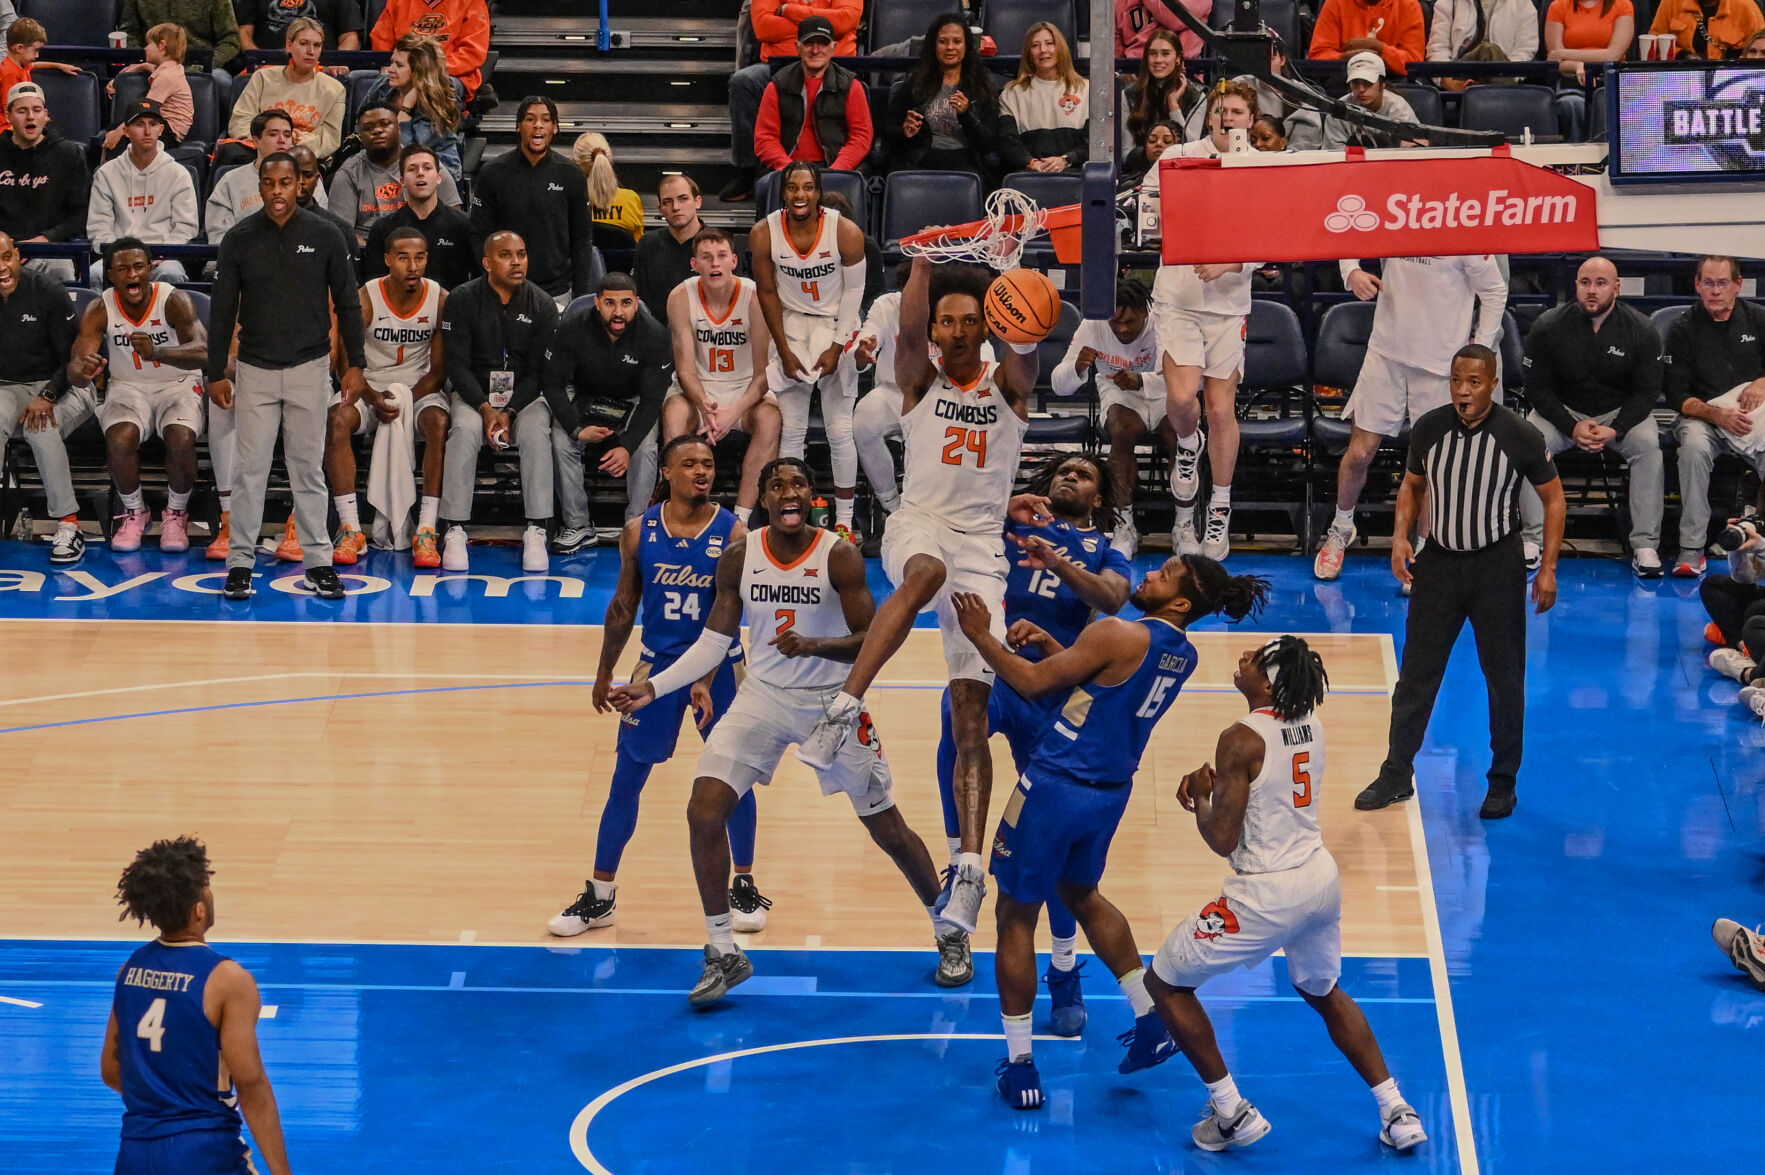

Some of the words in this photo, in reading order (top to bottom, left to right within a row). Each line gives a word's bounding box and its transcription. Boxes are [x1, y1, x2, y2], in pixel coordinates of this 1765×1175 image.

[1673, 109, 1762, 136] BATTLE
[780, 263, 836, 279] COWBOYS
[800, 280, 820, 301] 4
[994, 282, 1026, 324] Wilson
[114, 331, 169, 347] COYS
[374, 328, 431, 343] COWBOYS
[696, 328, 748, 346] COWBOYS
[397, 345, 405, 366] 1
[708, 347, 735, 372] 13
[934, 398, 998, 425] COWBOYS
[941, 425, 988, 468] 24
[647, 519, 658, 527] 32
[651, 562, 714, 588] Tulsa
[1028, 569, 1061, 599] 12
[663, 591, 701, 620] 24
[750, 583, 821, 604] COWBOYS
[774, 608, 796, 635] 2
[1158, 653, 1188, 673] GARCIA
[1135, 675, 1177, 718] 15
[1280, 724, 1313, 746] WILLIAMS
[1292, 751, 1312, 808] 5
[124, 967, 194, 992] HAGGERTY
[137, 998, 166, 1052] 4
